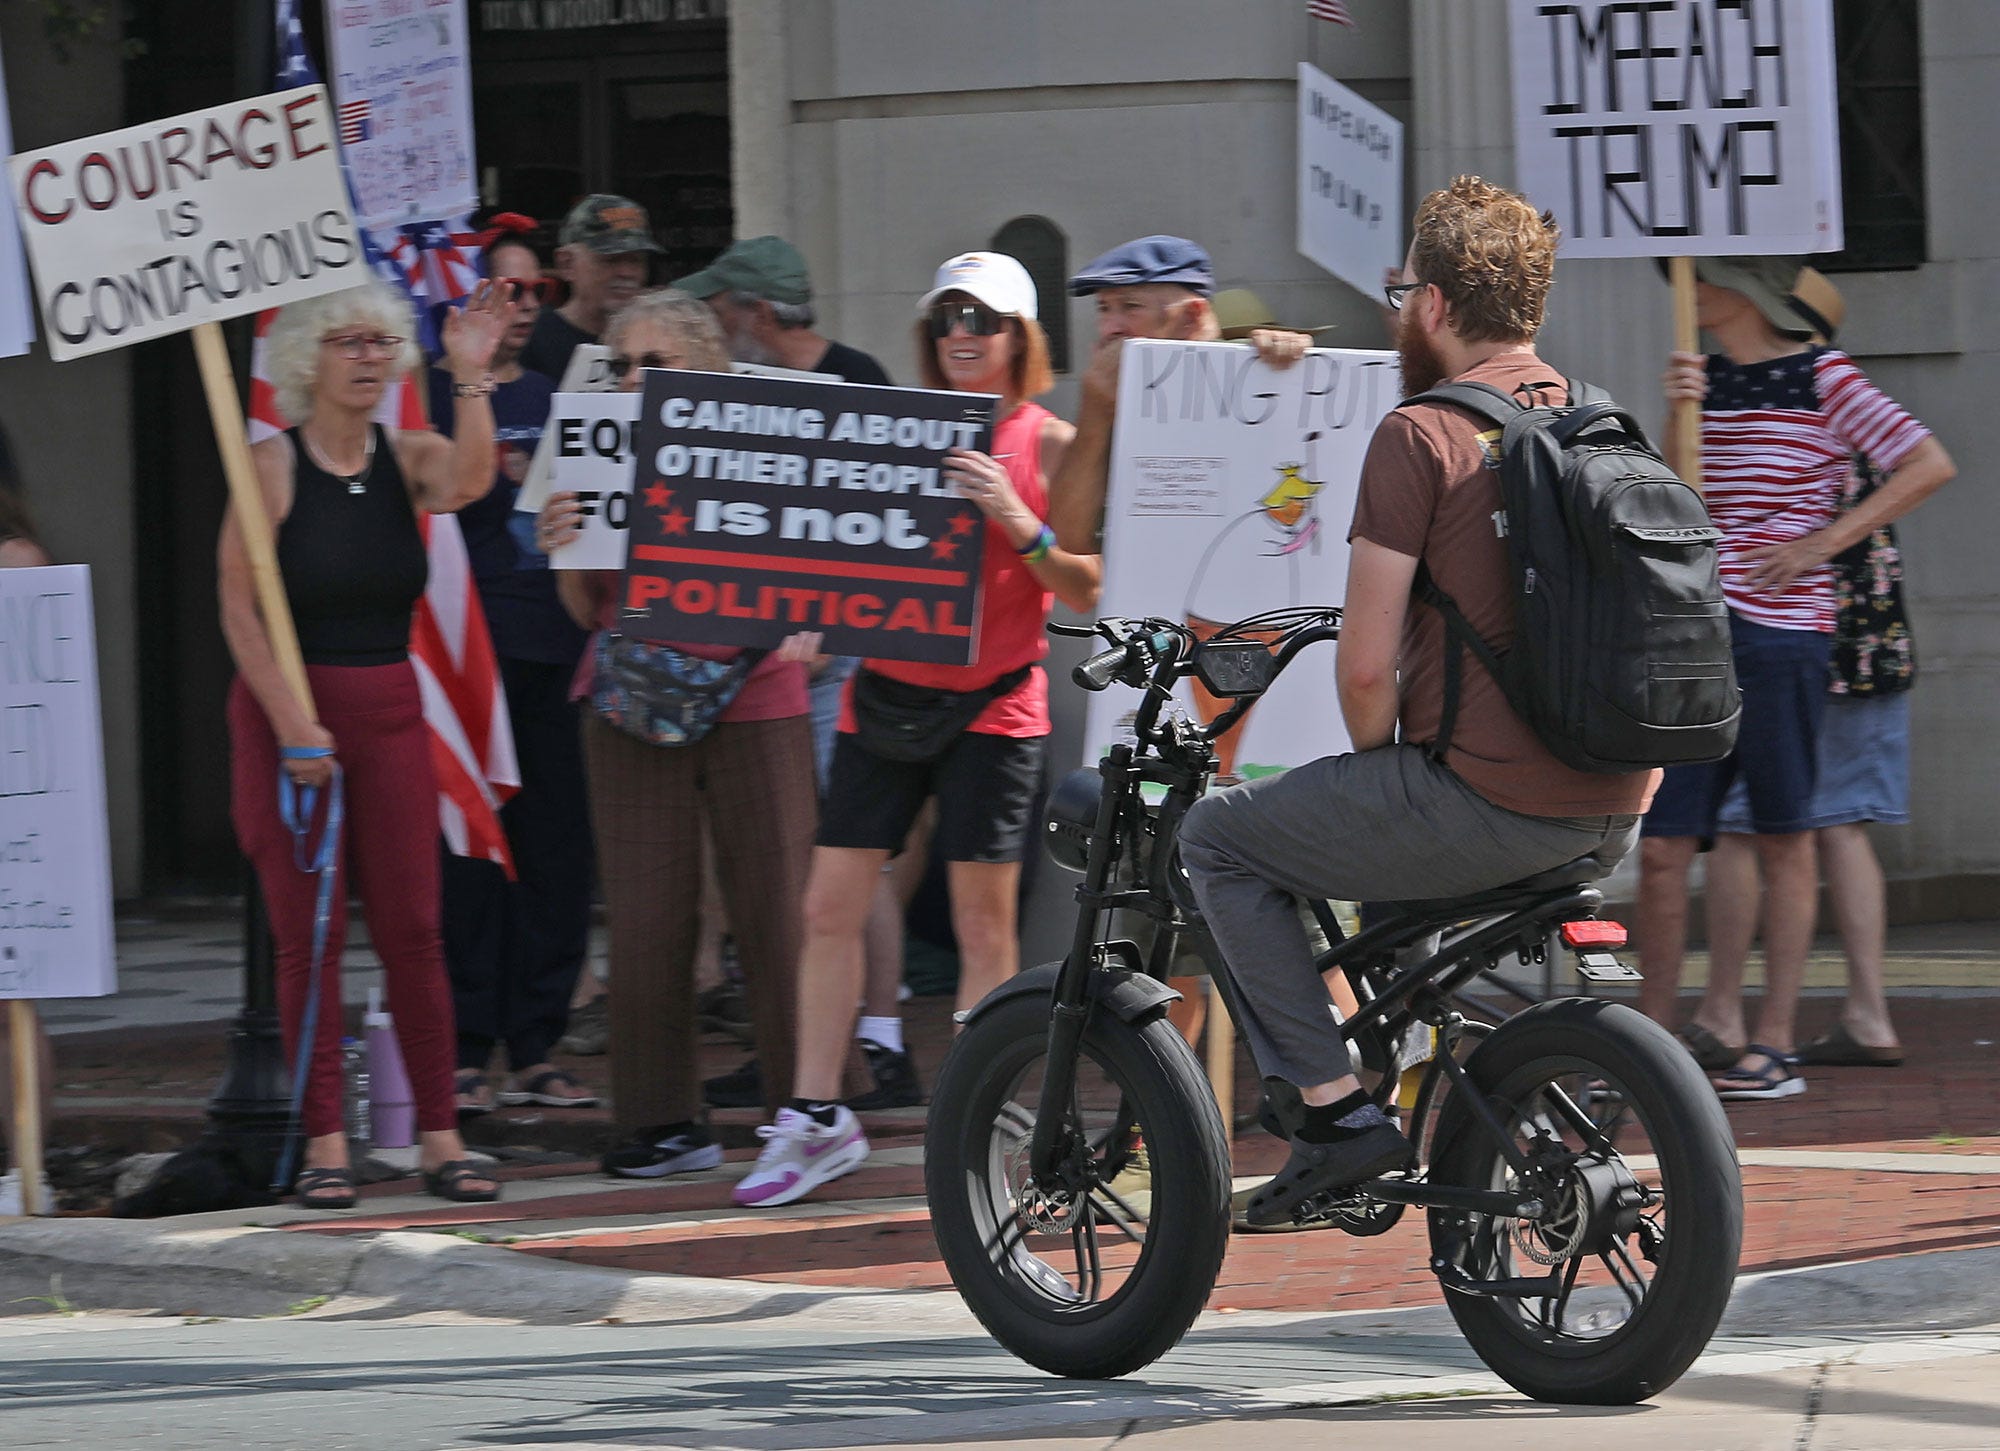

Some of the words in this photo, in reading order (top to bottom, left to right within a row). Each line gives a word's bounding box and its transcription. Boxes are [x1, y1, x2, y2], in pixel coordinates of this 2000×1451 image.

[1539, 0, 1789, 115] IMPEACH
[23, 93, 332, 225] COURAGE
[1552, 121, 1779, 238] TRUMP
[156, 200, 205, 242] IS
[50, 209, 357, 344] CONTAGIOUS
[660, 397, 826, 441] CARING
[828, 411, 985, 451] ABOUT
[1298, 353, 1399, 432] PUT
[655, 444, 809, 488] OTHER
[779, 506, 930, 550] not
[626, 574, 972, 638] POLITICAL
